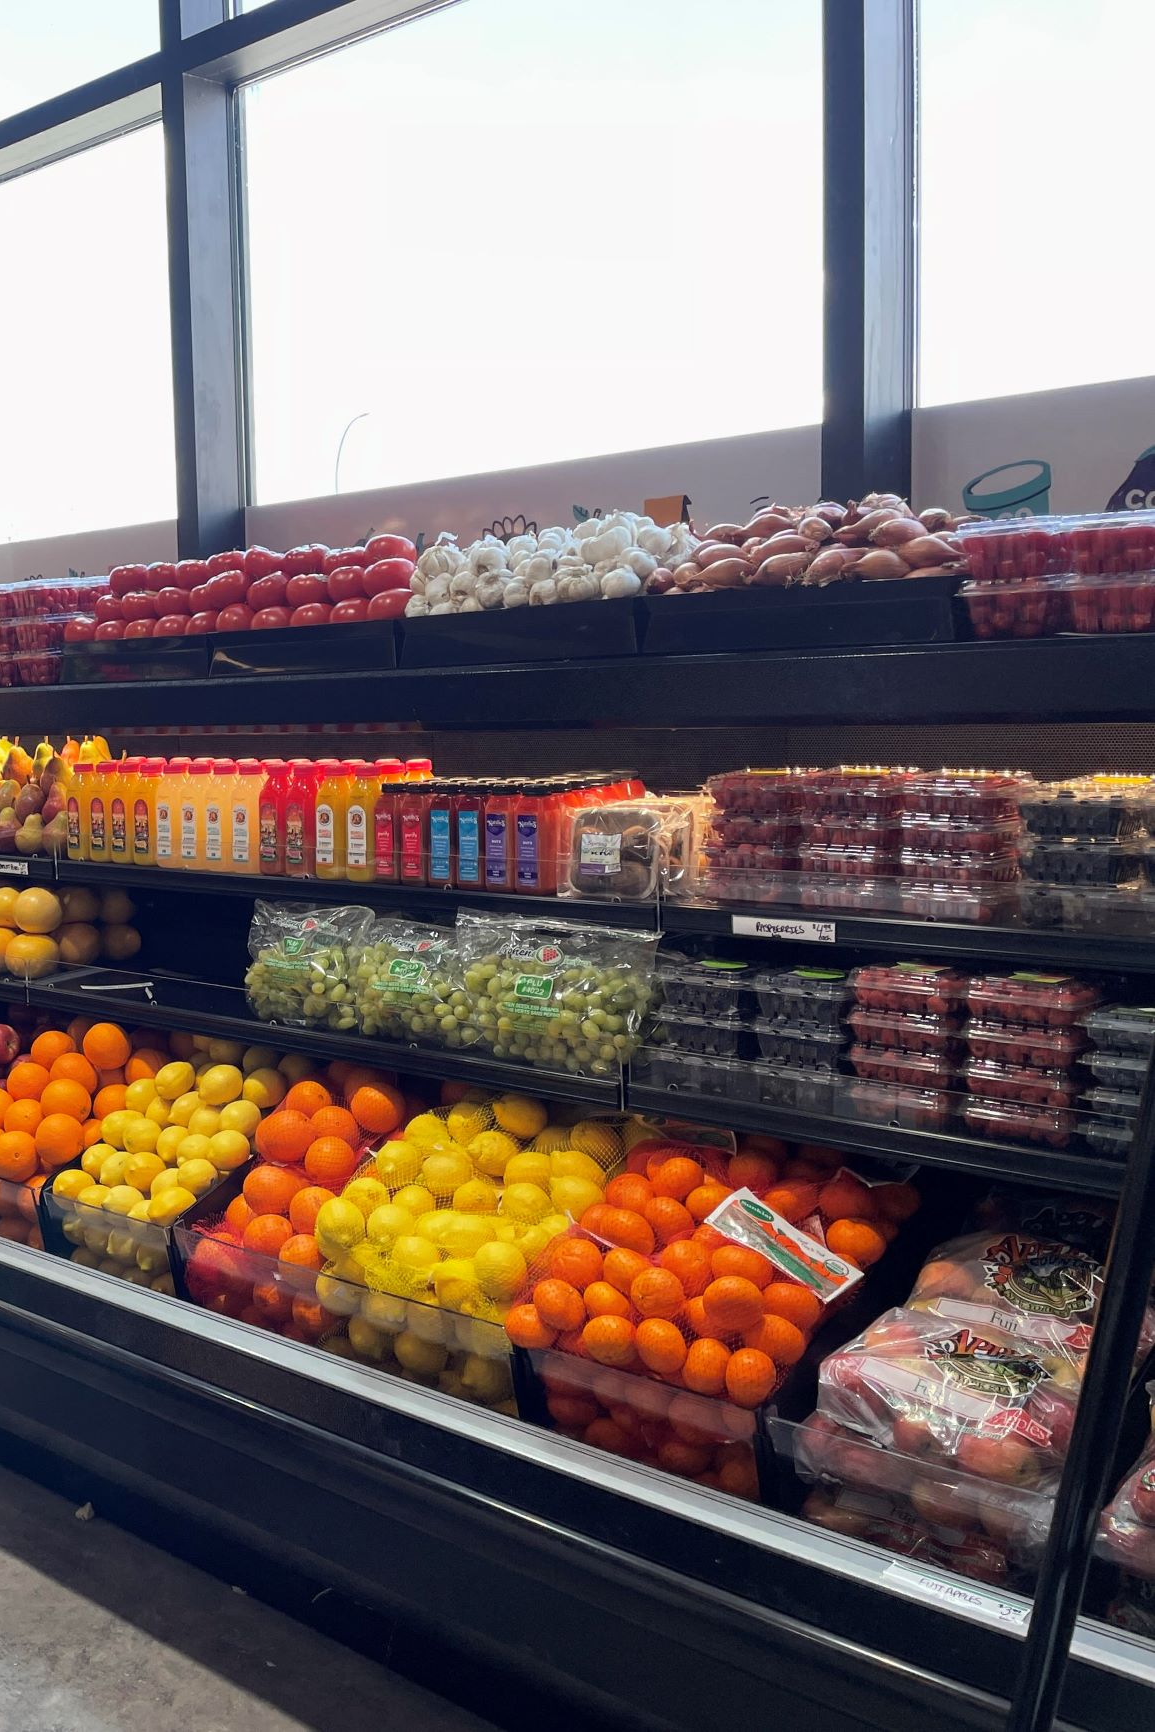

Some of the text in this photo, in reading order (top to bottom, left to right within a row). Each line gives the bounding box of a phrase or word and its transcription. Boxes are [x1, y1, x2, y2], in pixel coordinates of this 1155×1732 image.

[756, 921, 805, 934] RASPBERRIES
[526, 979, 544, 988] PLU
[989, 1311, 1019, 1332] Fuji
[945, 1587, 983, 1606] APPLES
